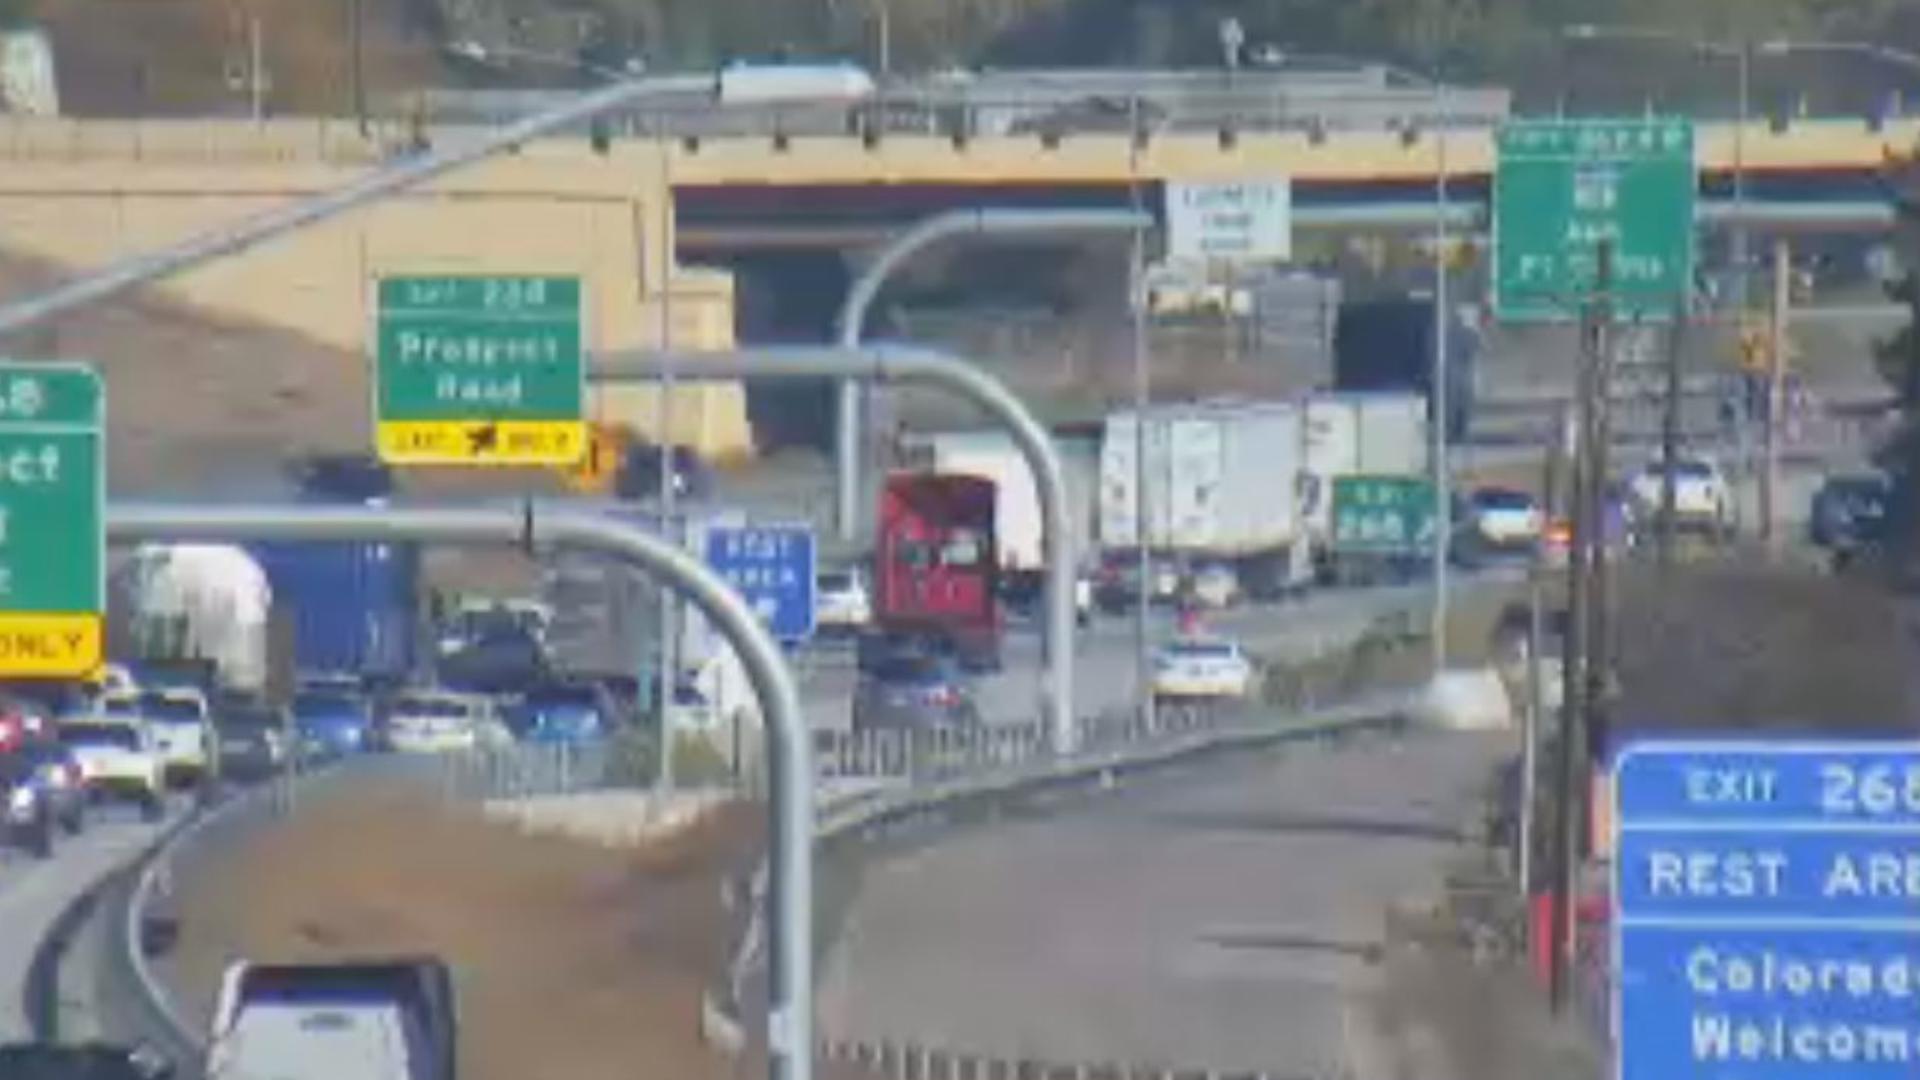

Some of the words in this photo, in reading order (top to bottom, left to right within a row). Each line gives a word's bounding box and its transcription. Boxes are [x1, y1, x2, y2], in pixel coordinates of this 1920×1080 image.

[1687, 769, 1778, 802] EXIT
[1650, 852, 1788, 897] REST
[1686, 947, 1920, 997] Colorad
[1691, 1015, 1920, 1062] Welcom
